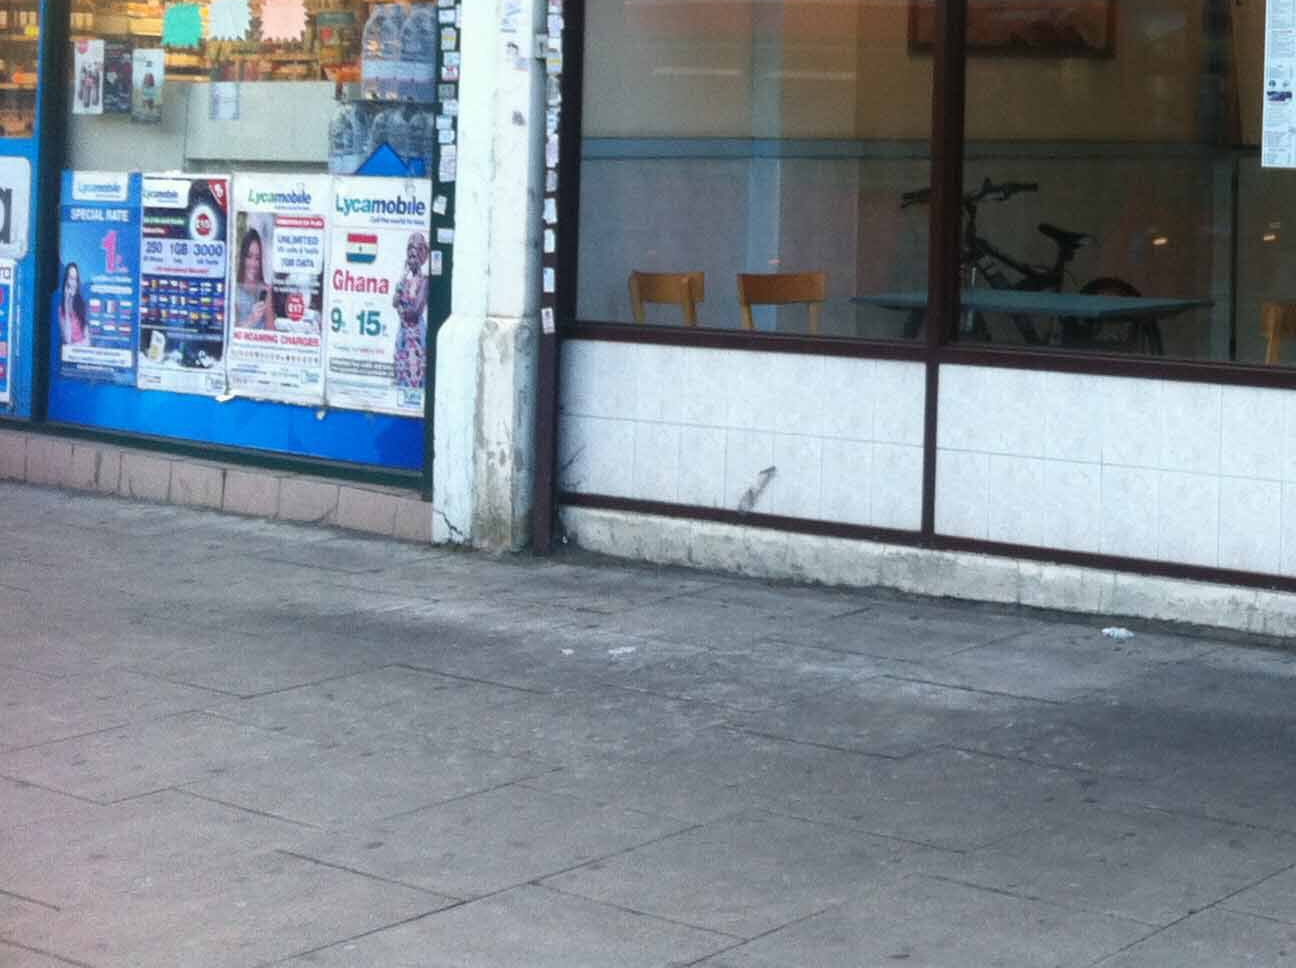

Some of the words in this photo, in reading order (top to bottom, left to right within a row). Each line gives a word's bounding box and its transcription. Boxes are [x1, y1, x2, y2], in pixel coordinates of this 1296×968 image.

[248, 188, 312, 207] Lycamobile
[335, 193, 426, 216] Lycamobile
[70, 207, 104, 221] SPECIAL
[105, 208, 129, 222] RATE
[192, 243, 224, 257] 3000
[332, 269, 390, 295] Ghana
